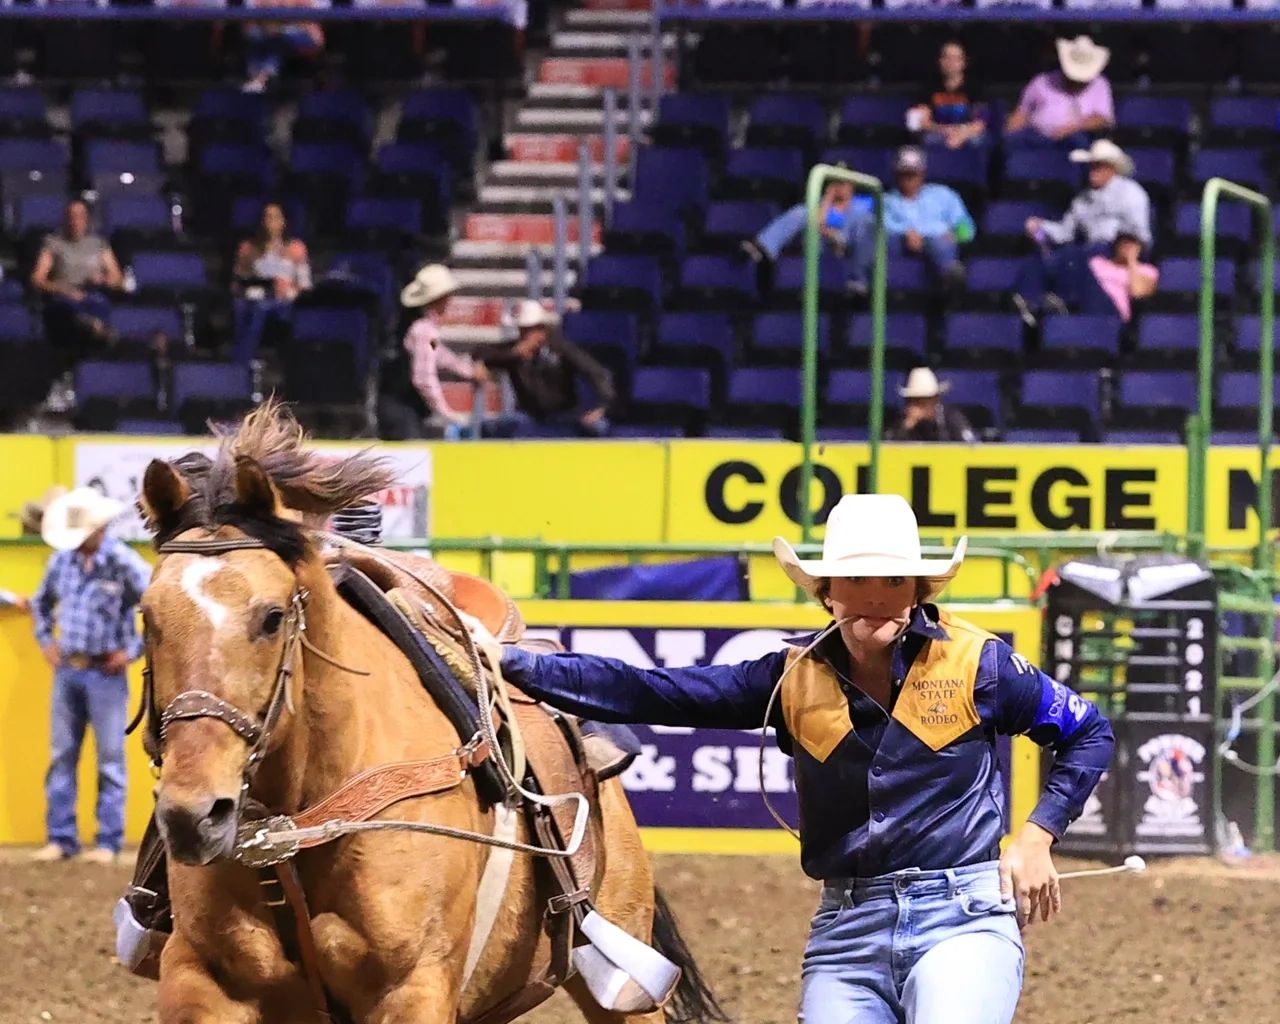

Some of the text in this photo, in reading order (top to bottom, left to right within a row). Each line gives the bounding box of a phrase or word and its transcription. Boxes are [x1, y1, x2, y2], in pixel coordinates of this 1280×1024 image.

[912, 679, 965, 692] MONTANA
[920, 689, 957, 700] STATE
[921, 714, 958, 725] RODEO
[620, 744, 798, 793] & SH
